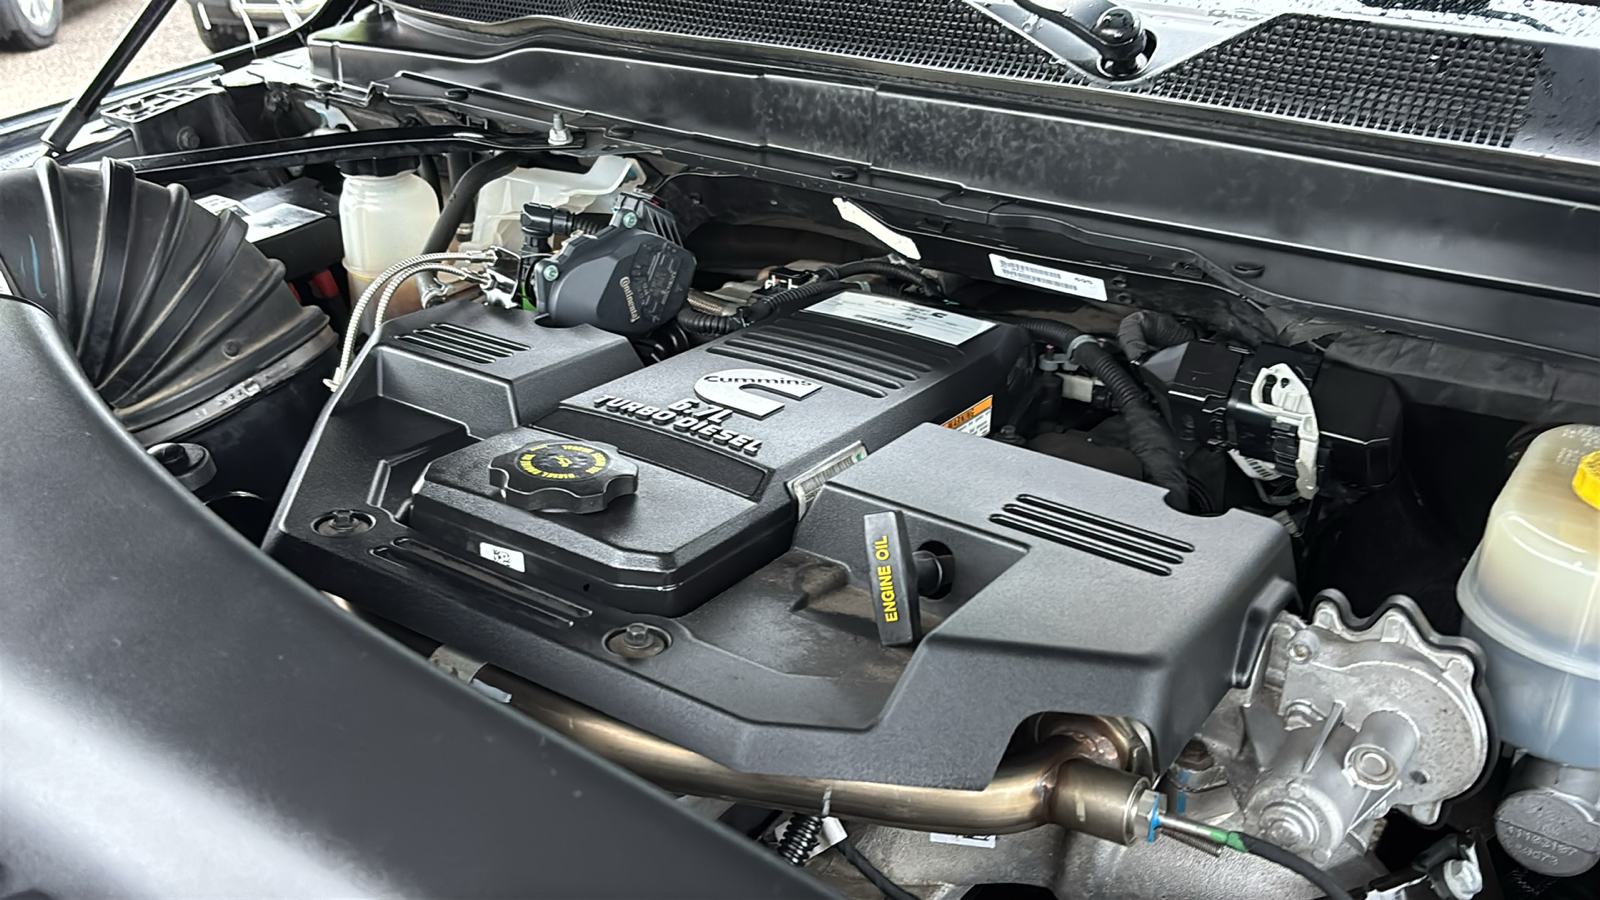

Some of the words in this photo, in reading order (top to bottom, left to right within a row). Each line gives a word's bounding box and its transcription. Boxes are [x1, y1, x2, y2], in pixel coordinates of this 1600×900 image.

[619, 276, 640, 323] Continental
[703, 375, 812, 386] Cummins
[594, 395, 677, 425] TURBO
[673, 416, 763, 456] DIESEL
[667, 397, 734, 424] 6.7L
[874, 535, 890, 561] OIL
[877, 565, 899, 622] ENGINE
